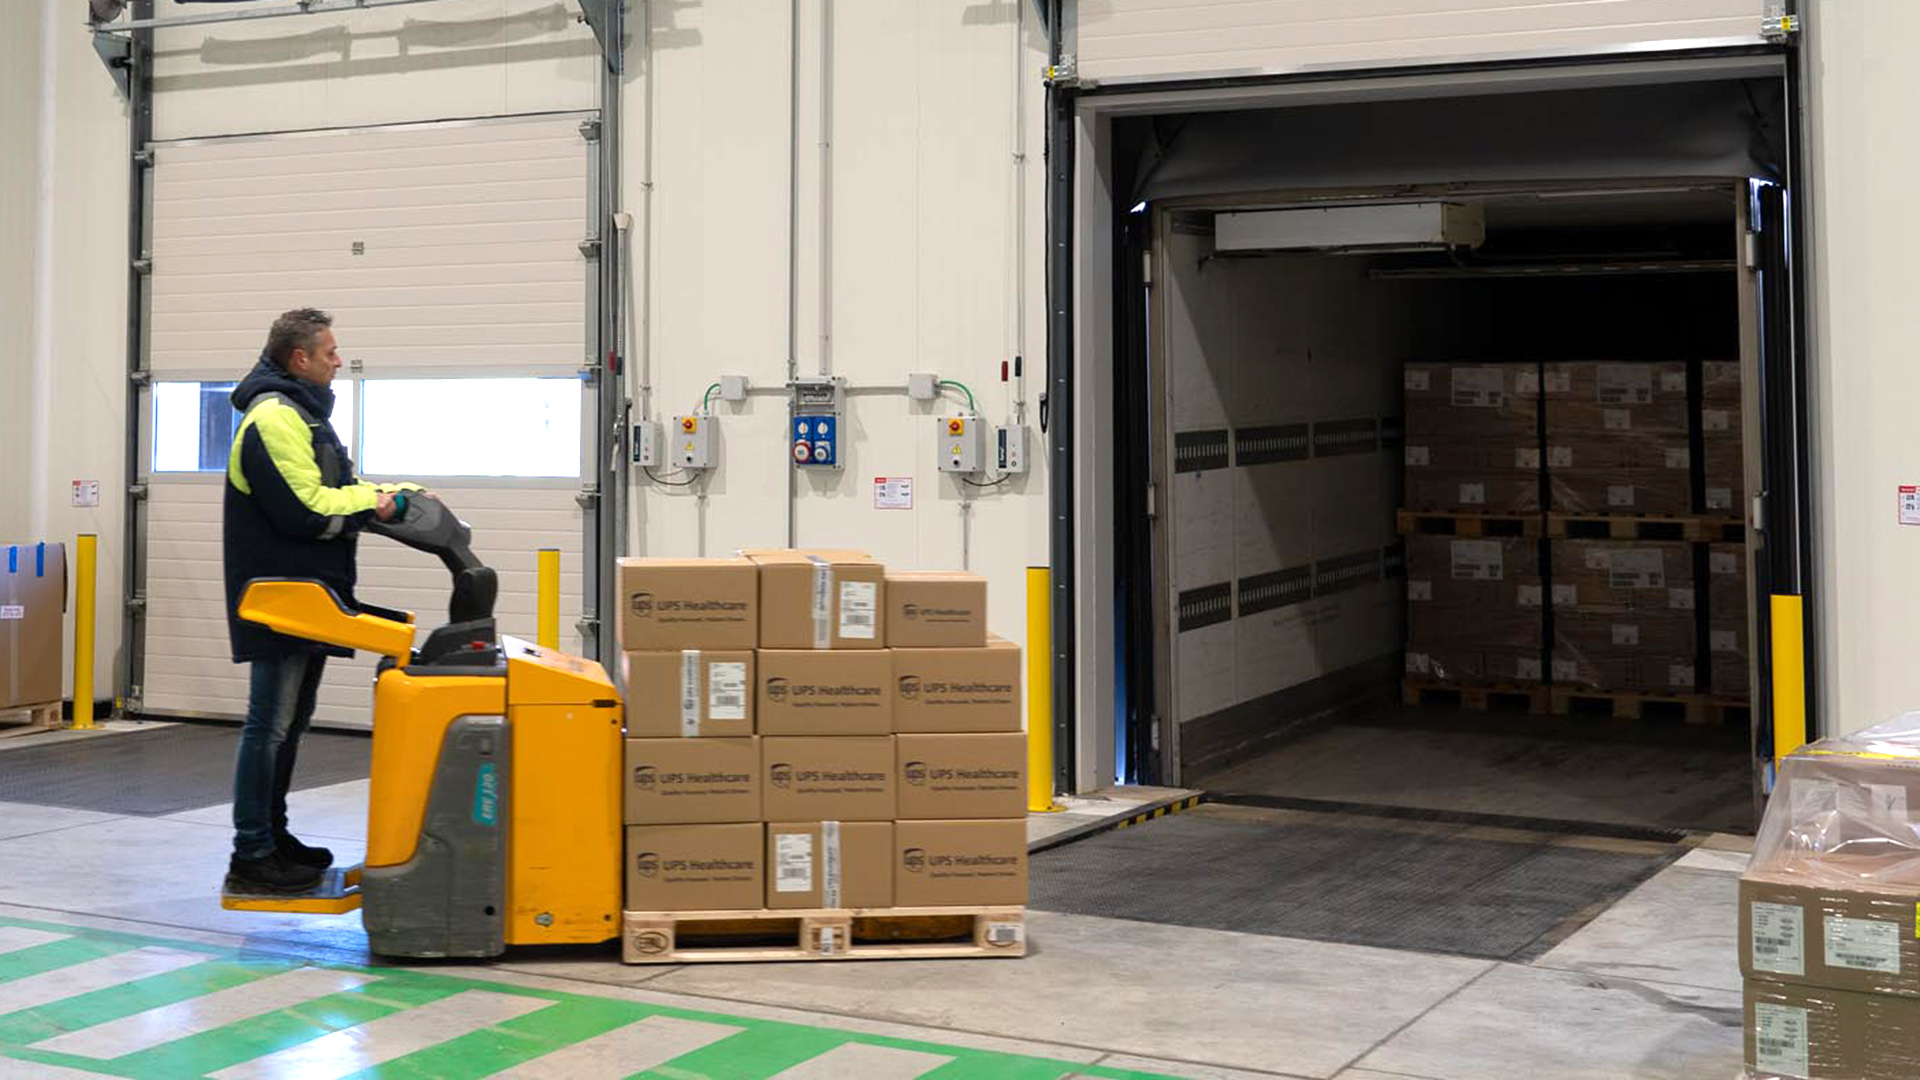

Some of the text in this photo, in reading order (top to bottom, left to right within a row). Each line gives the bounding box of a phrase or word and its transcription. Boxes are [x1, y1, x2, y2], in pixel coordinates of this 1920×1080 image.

[657, 599, 748, 611] UPS Healthcare
[792, 684, 881, 696] UPS Healthcare
[923, 682, 1012, 694] UPS Healthcare
[660, 772, 750, 784] UPS Healthcare
[796, 770, 886, 782] UPS Healthcare
[929, 767, 1020, 780] UPS Healthcare
[663, 859, 755, 871] UPS Healthcare
[928, 854, 1019, 866] UPS Healthcare
